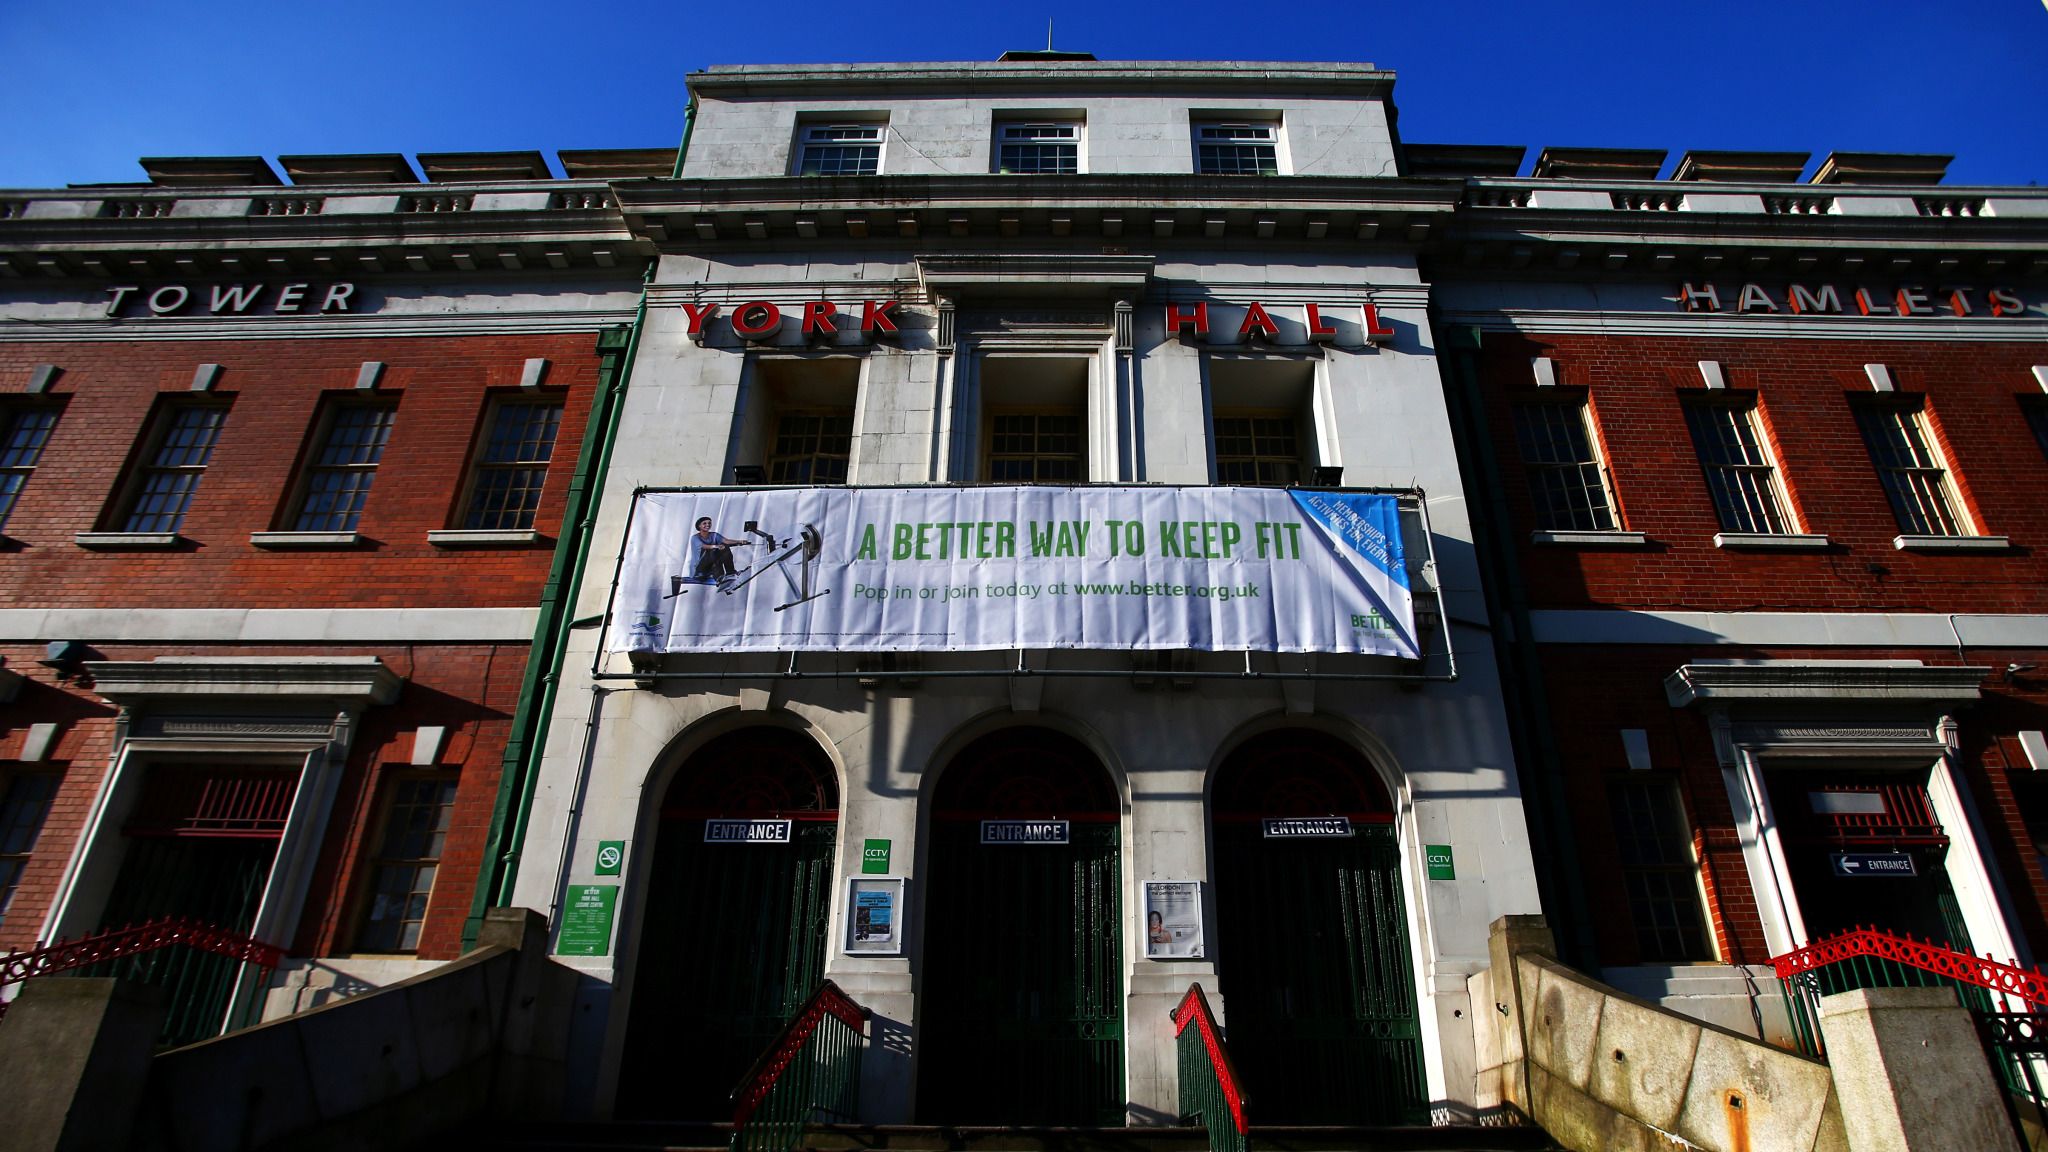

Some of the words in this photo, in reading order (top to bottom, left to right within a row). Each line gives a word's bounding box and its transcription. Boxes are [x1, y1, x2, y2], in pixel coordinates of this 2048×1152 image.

[105, 283, 355, 317] TOWER
[1680, 283, 2024, 317] HAMLETS
[680, 300, 901, 340] YORK
[1165, 301, 1395, 342] HALL
[1332, 500, 1386, 545] MEMBERSHIPS
[857, 523, 877, 560] A
[892, 521, 1015, 561] BETTER
[1029, 520, 1091, 558] WAY
[1104, 520, 1145, 558] TO
[1159, 520, 1241, 559] KEEP
[1254, 521, 1302, 560] FIT
[1346, 525, 1365, 542] FOR
[1361, 538, 1402, 573] EVERYONE
[854, 583, 889, 602] Pop
[895, 585, 912, 599] in
[918, 587, 938, 599] or
[941, 585, 979, 603] join
[985, 582, 1042, 600] today
[1047, 581, 1068, 595] at
[1074, 580, 1260, 601] www.better.org.uk
[711, 824, 785, 839] ENTRANCE
[987, 825, 1061, 840] ENTRANCE
[1270, 821, 1344, 834] ENTRANCE
[865, 849, 888, 857] CCTV
[1428, 855, 1450, 863] CCTV
[1868, 860, 1911, 870] ENTRANCE
